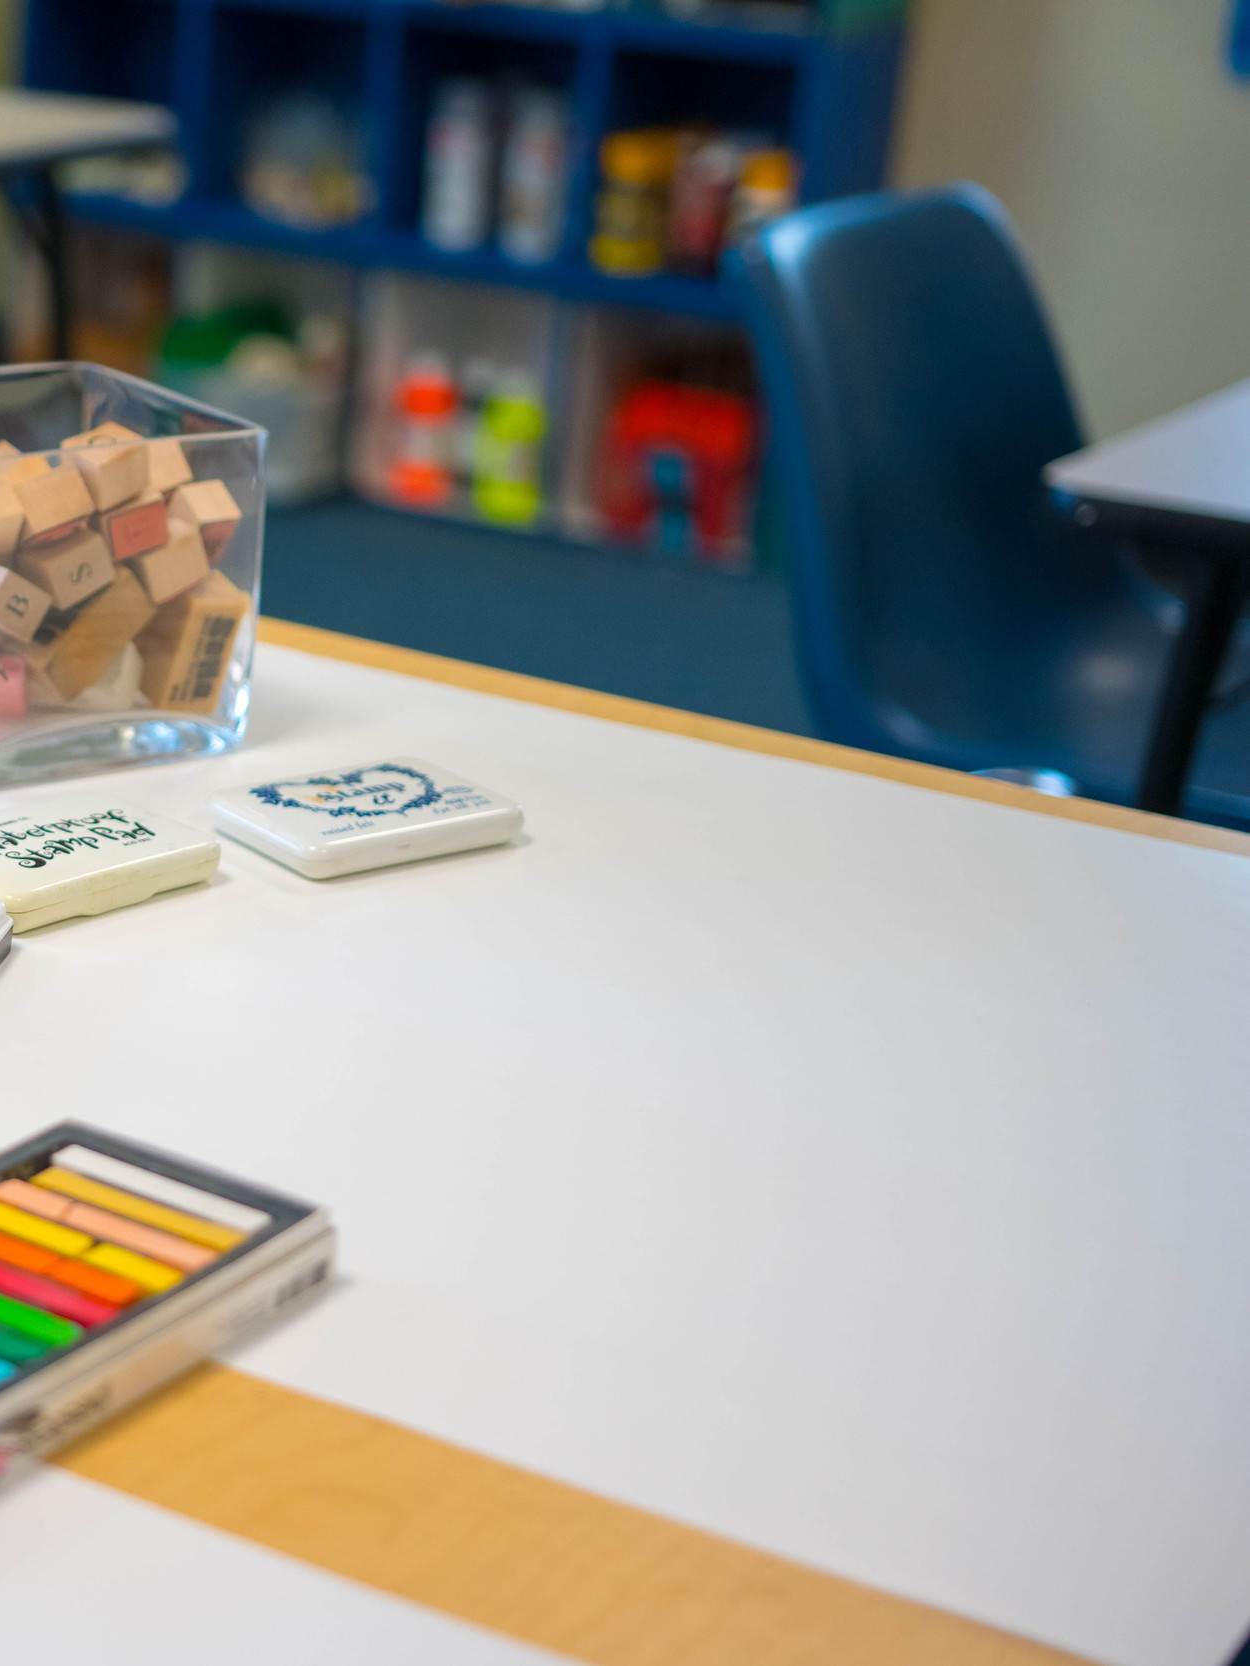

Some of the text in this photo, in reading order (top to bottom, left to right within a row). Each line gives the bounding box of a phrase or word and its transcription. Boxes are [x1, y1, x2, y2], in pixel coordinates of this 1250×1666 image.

[68, 562, 93, 585] S
[5, 594, 30, 617] B
[316, 782, 405, 802] Stamp
[372, 793, 396, 805] it
[5, 821, 156, 869] Stamp Pad
